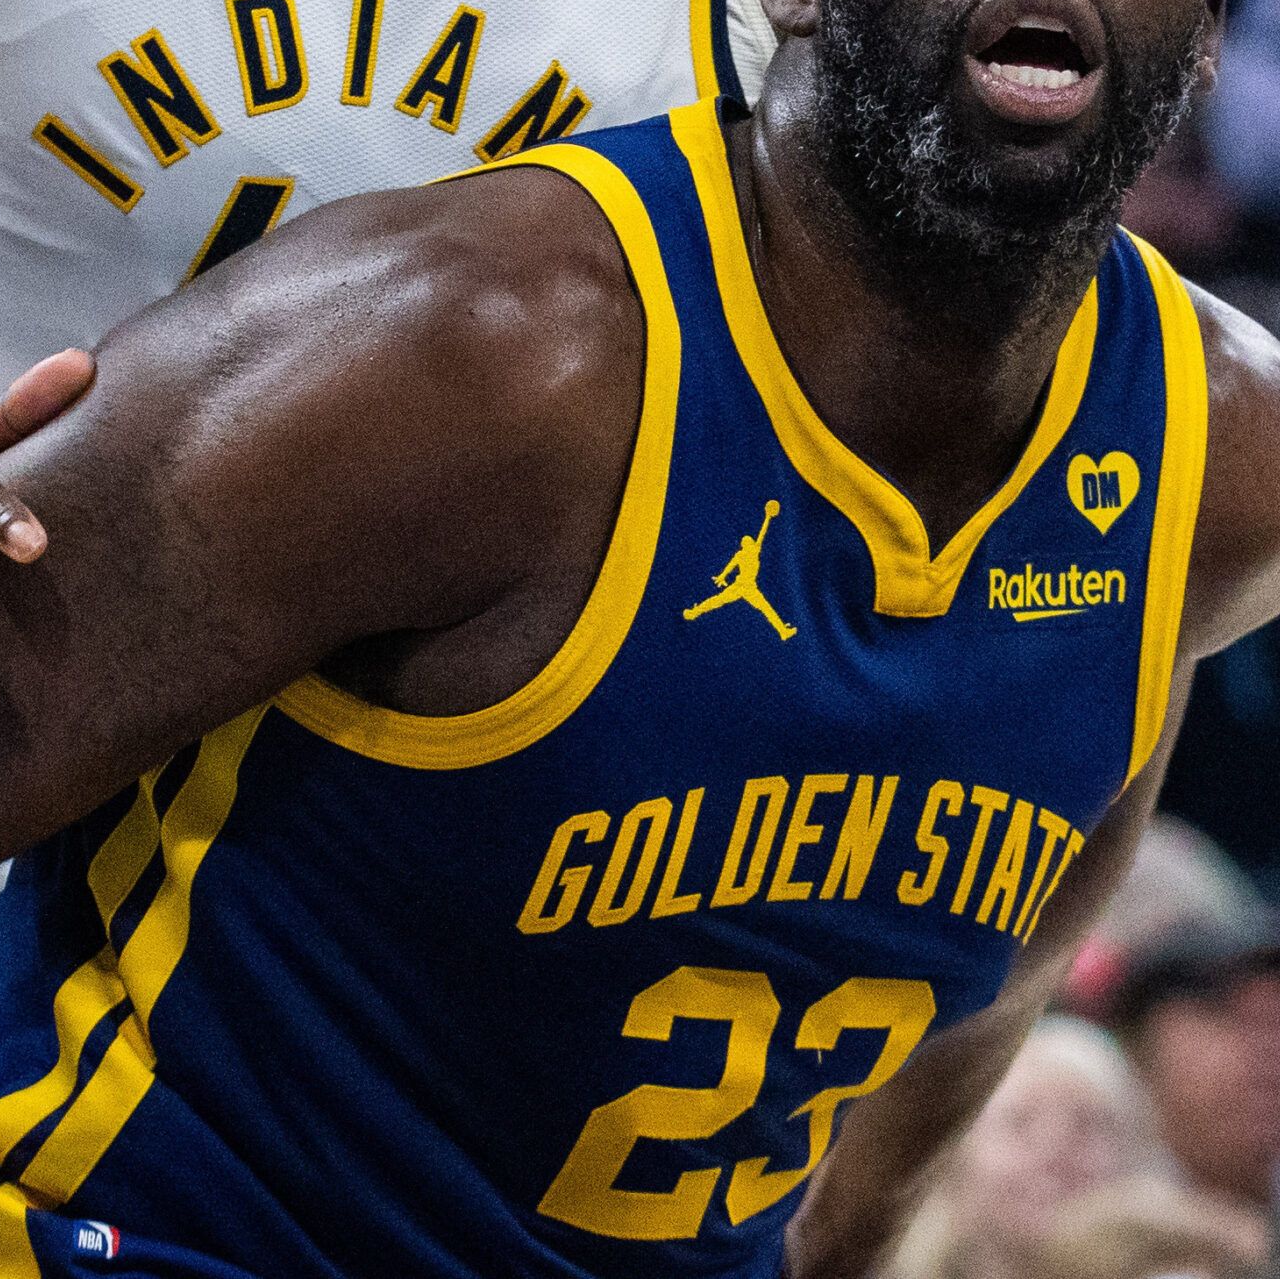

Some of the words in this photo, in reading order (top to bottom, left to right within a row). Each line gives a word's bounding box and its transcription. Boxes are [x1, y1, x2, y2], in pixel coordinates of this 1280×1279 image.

[1081, 470, 1122, 510] DM
[987, 562, 1127, 610] Rakuten
[516, 773, 900, 934] GOLDEN
[536, 965, 937, 1241] 23
[78, 1228, 103, 1251] NBA
